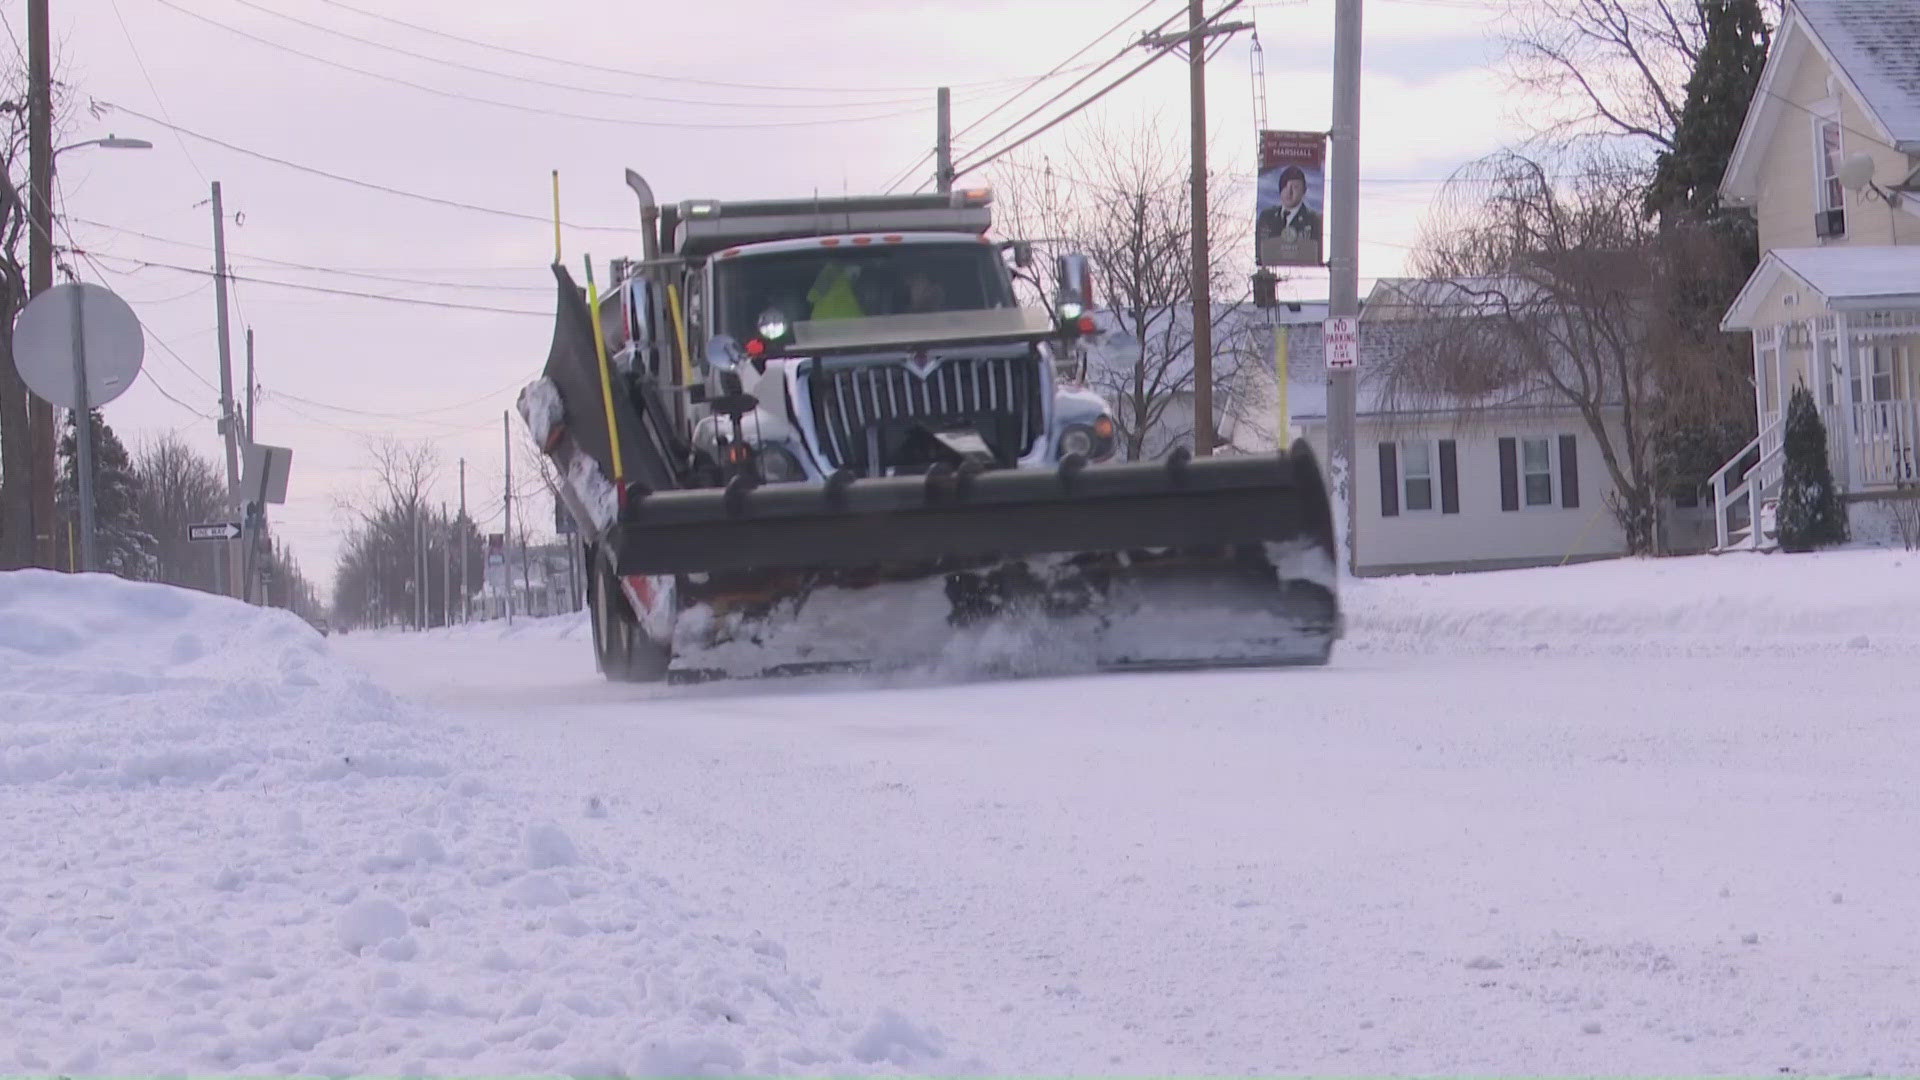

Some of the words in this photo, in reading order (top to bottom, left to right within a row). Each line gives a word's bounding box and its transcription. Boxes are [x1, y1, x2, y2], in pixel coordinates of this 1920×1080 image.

[1272, 148, 1311, 157] MARSHALL
[1334, 321, 1347, 332] NO
[1326, 333, 1356, 344] PARKING
[1333, 351, 1349, 359] TIME
[194, 528, 208, 537] ONE
[211, 527, 226, 536] WAY
